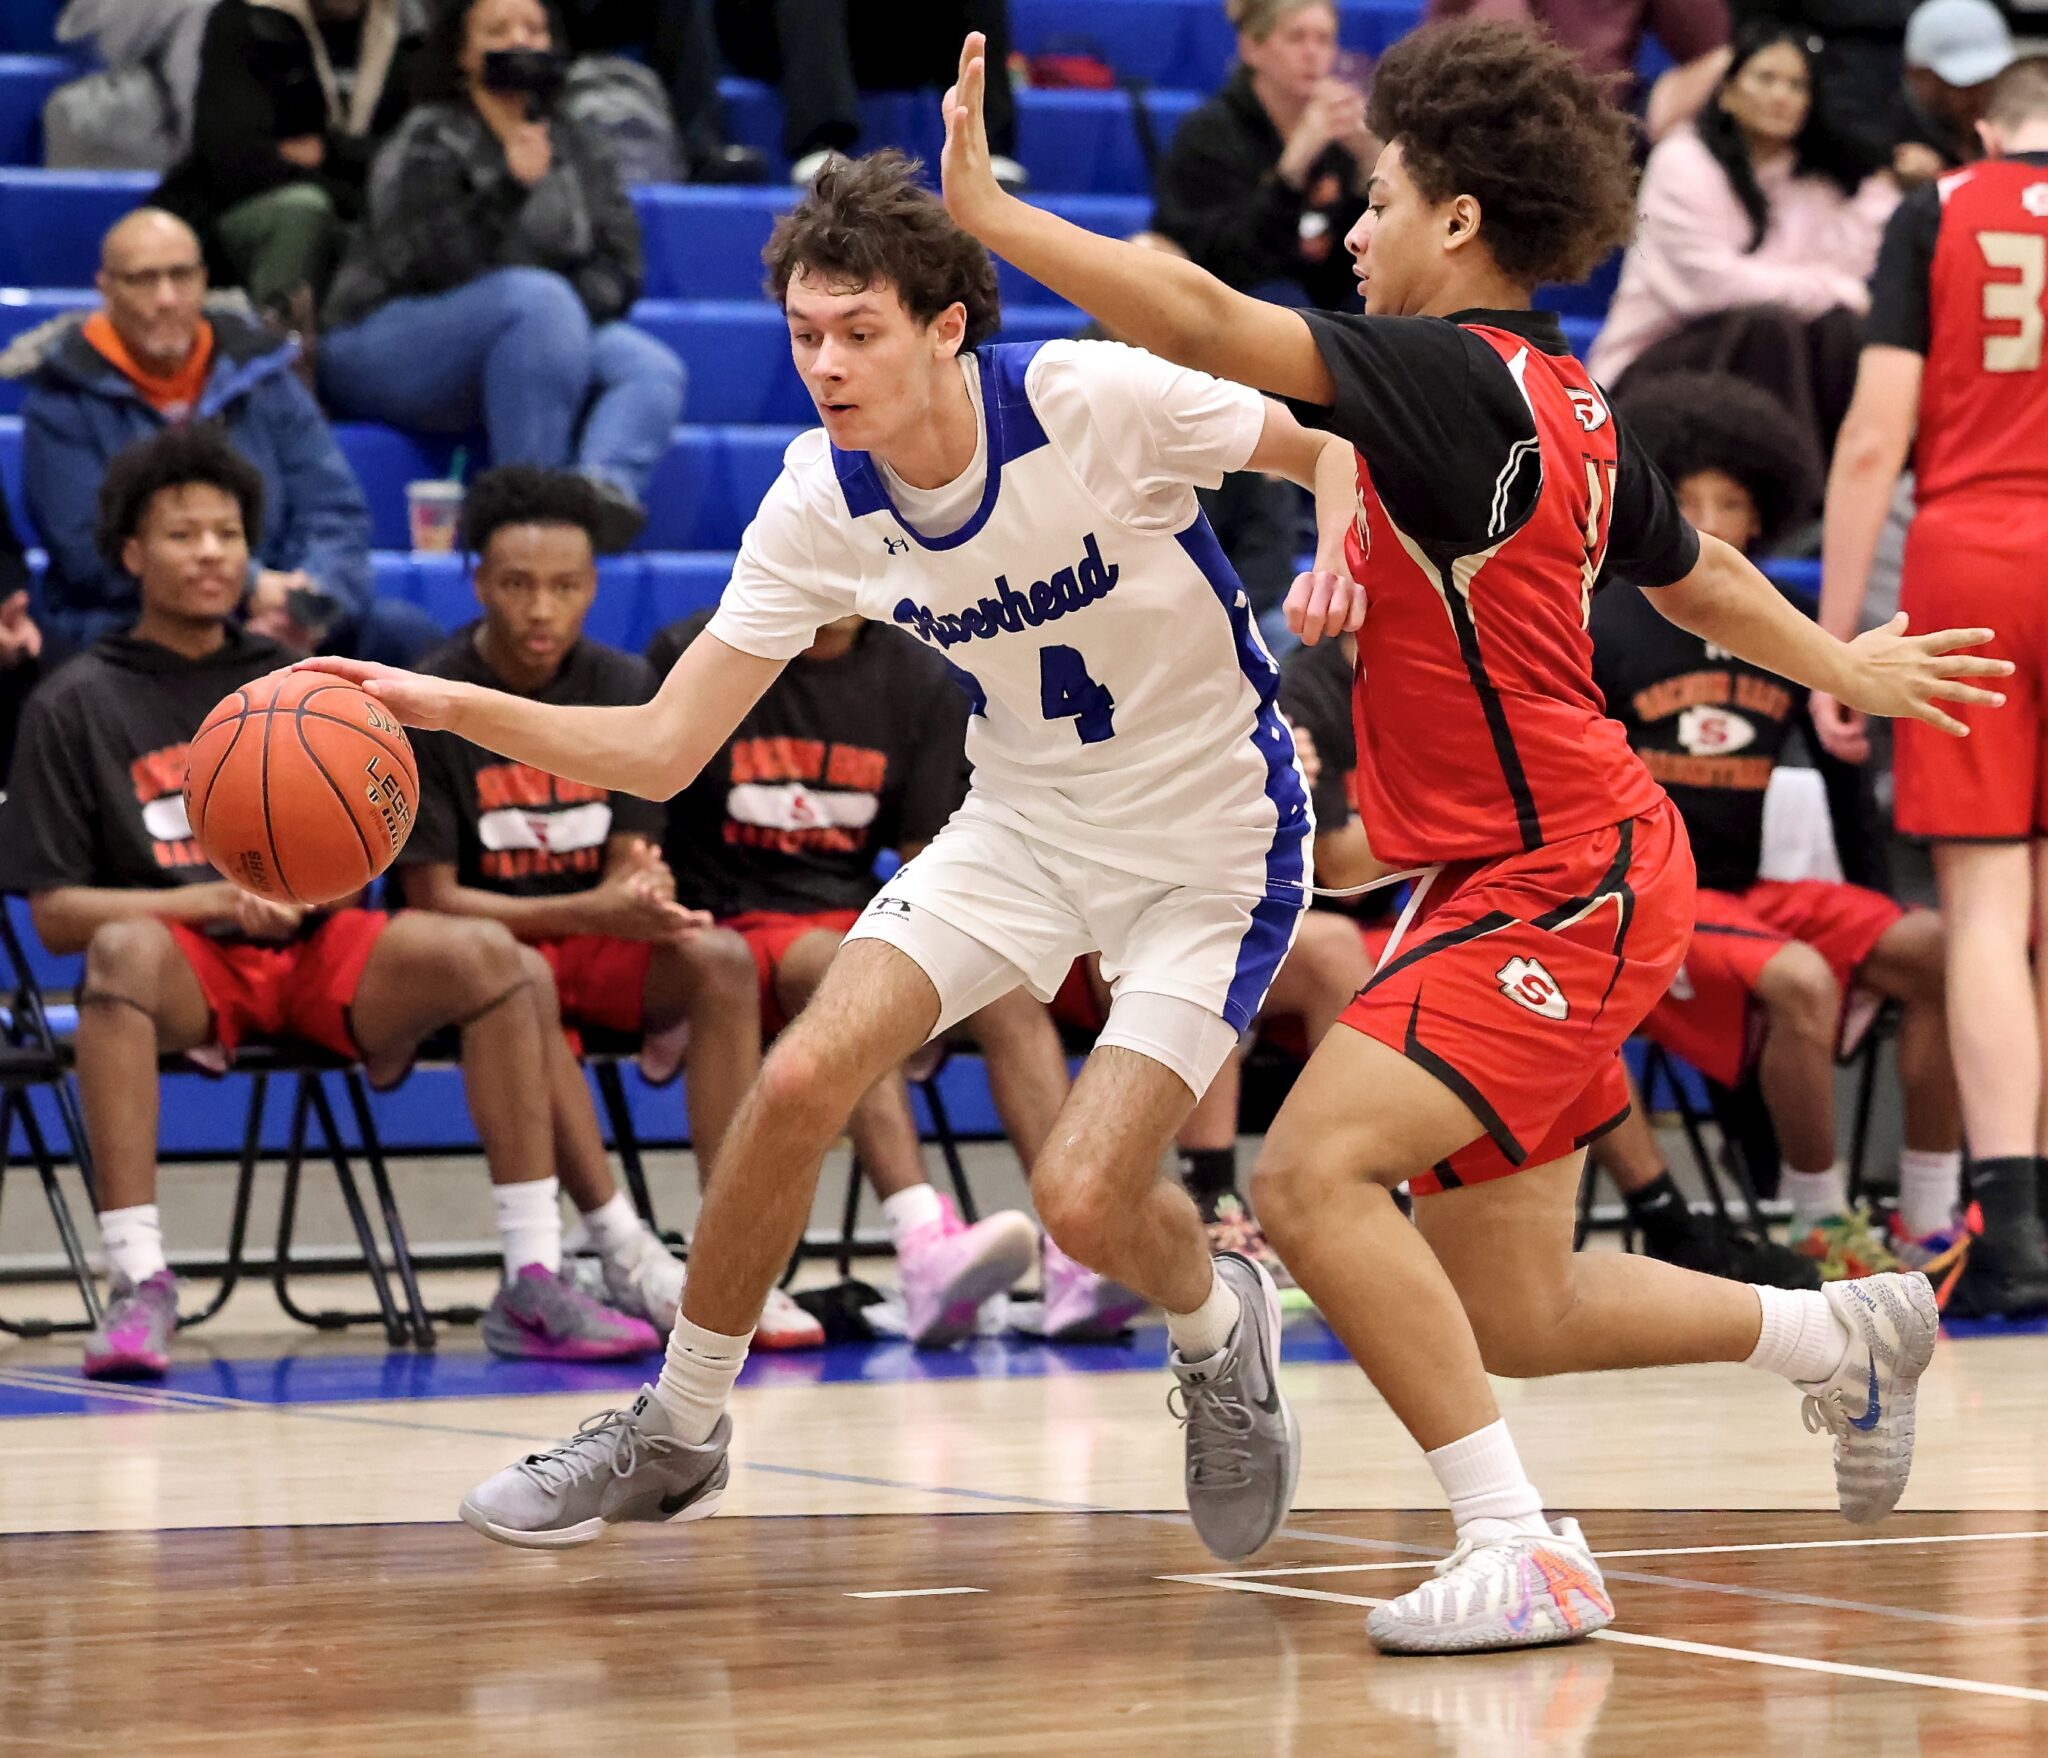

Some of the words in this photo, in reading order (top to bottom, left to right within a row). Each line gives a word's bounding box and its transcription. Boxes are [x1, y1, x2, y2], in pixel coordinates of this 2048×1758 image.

[893, 532, 1119, 650] Riverhead
[1039, 644, 1116, 745] 4
[1513, 973, 1555, 1006] S
